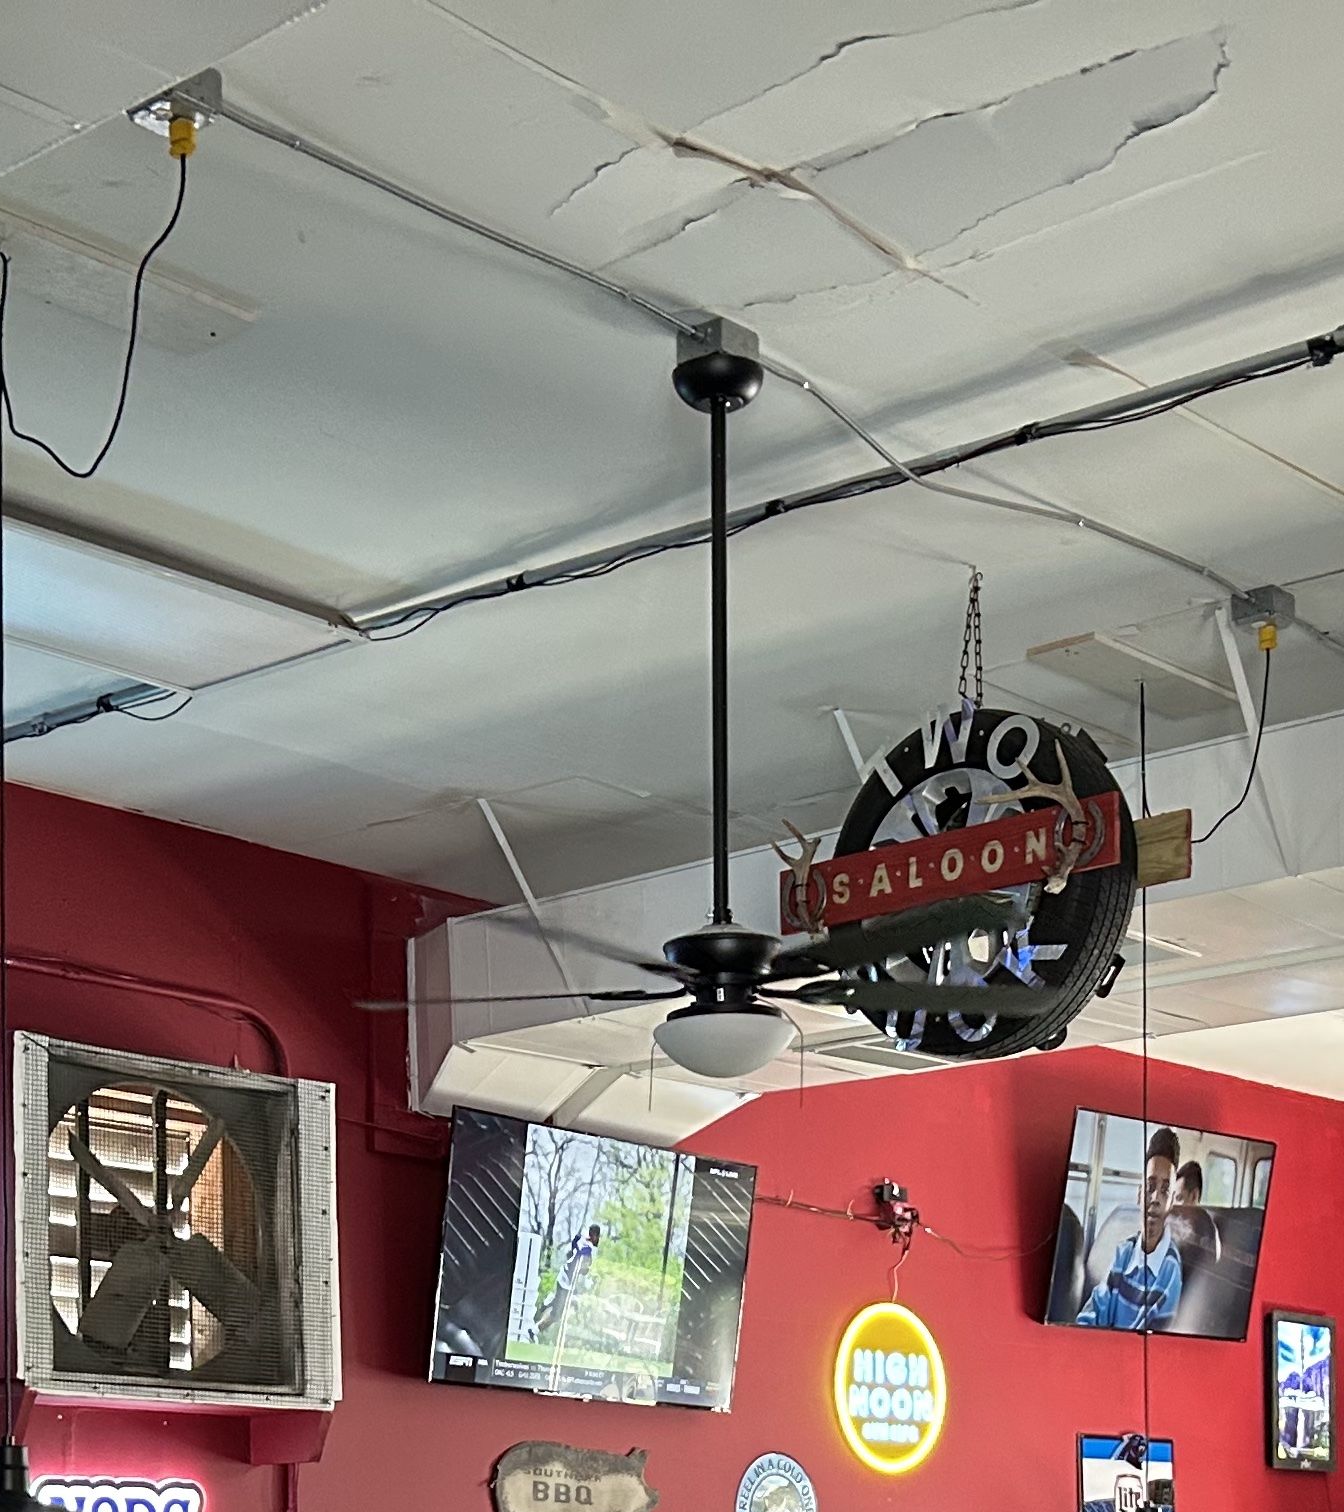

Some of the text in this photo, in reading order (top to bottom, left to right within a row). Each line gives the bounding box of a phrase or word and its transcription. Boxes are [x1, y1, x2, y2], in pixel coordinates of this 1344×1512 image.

[859, 699, 1040, 797] TWO
[853, 1348, 928, 1388] HIGH
[848, 1384, 935, 1421] NOON
[532, 1480, 594, 1505] BBQ
[738, 1476, 756, 1511] REEL
[767, 1458, 776, 1470] A
[777, 1459, 803, 1484] COLD
